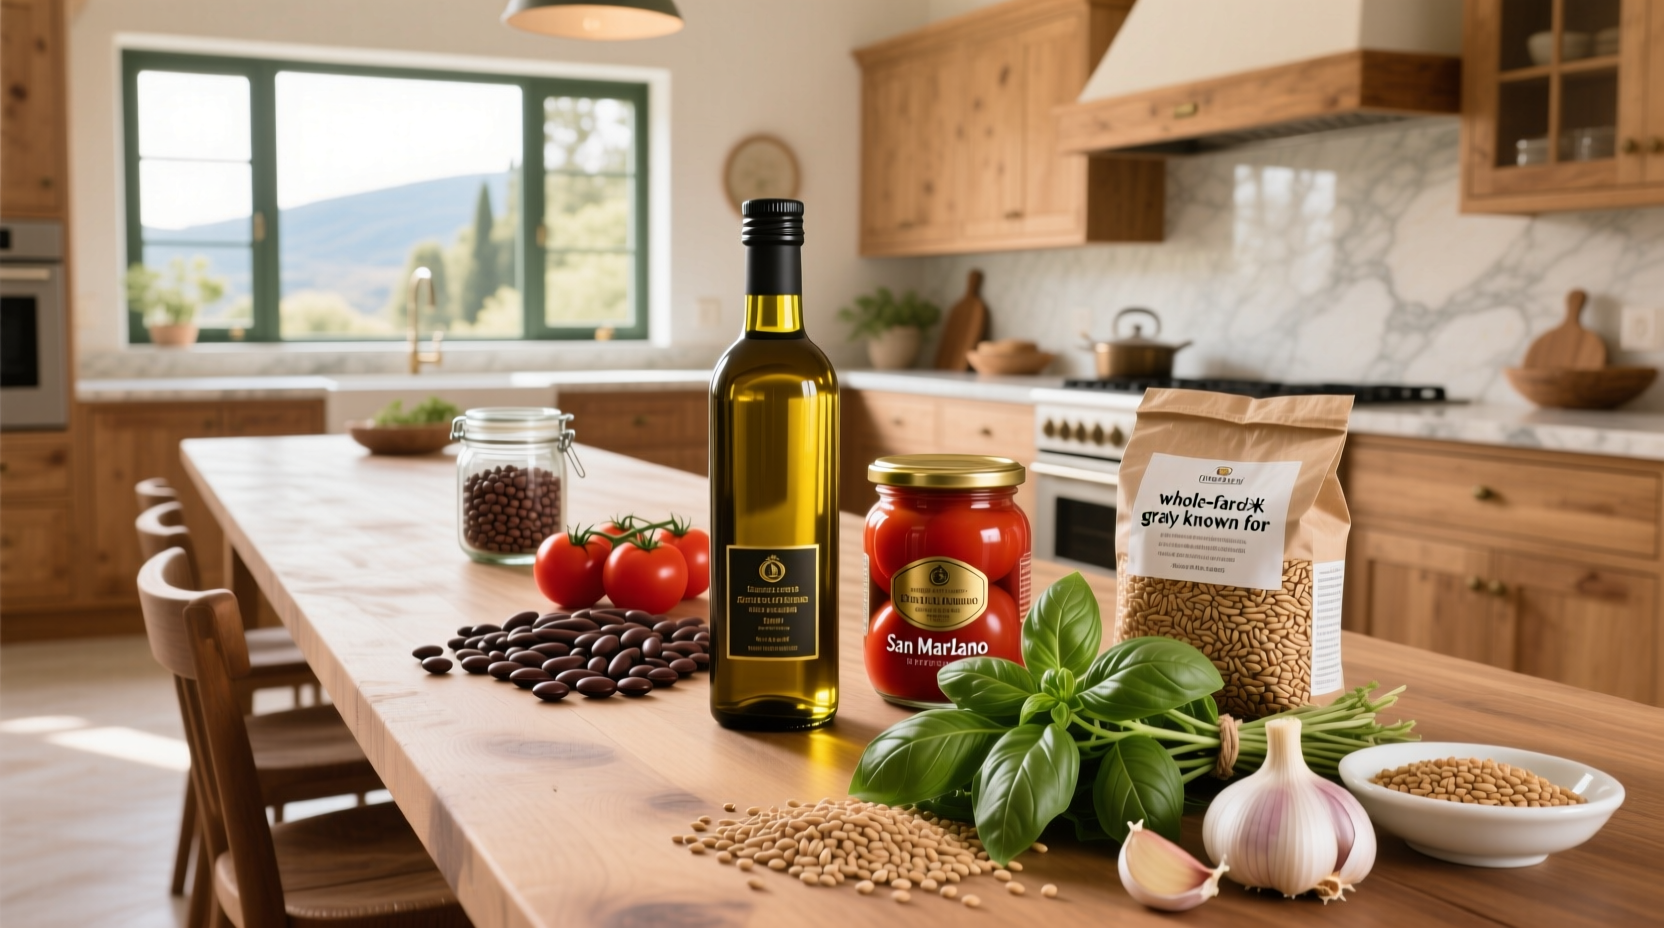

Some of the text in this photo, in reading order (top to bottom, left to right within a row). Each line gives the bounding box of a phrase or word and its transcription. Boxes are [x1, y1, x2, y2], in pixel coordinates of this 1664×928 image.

[1183, 510, 1239, 530] known
[1244, 515, 1270, 532] for
[886, 633, 913, 655] San
